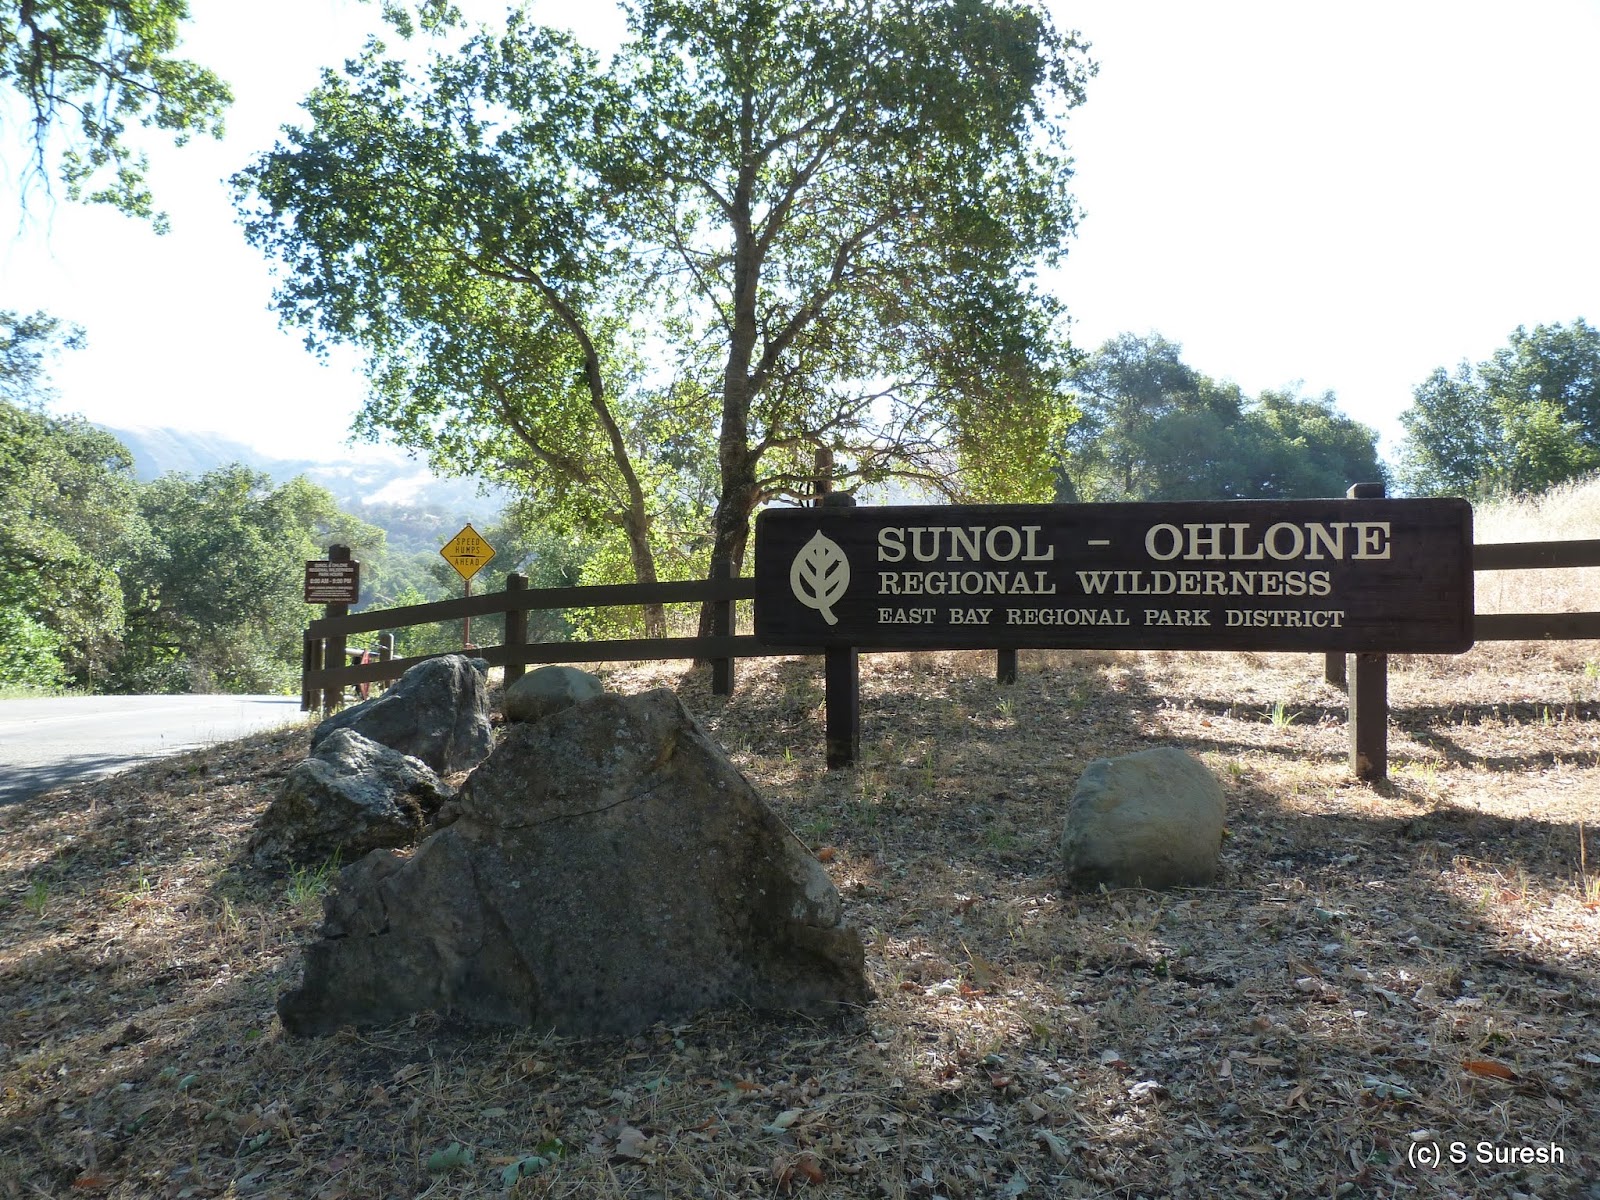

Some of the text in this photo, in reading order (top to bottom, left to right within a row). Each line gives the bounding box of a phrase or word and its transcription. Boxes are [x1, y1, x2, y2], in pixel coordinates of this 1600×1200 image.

[456, 537, 480, 546] SPEED
[877, 525, 1054, 562] SUNOL
[1144, 522, 1391, 560] OHLONE
[455, 546, 480, 554] HUMPS
[455, 558, 480, 566] AHEAD
[878, 570, 1332, 596] REGIONAL WILDERNESS
[878, 608, 1345, 628] EAST BAY REGIONAL PARK DISTRICT
